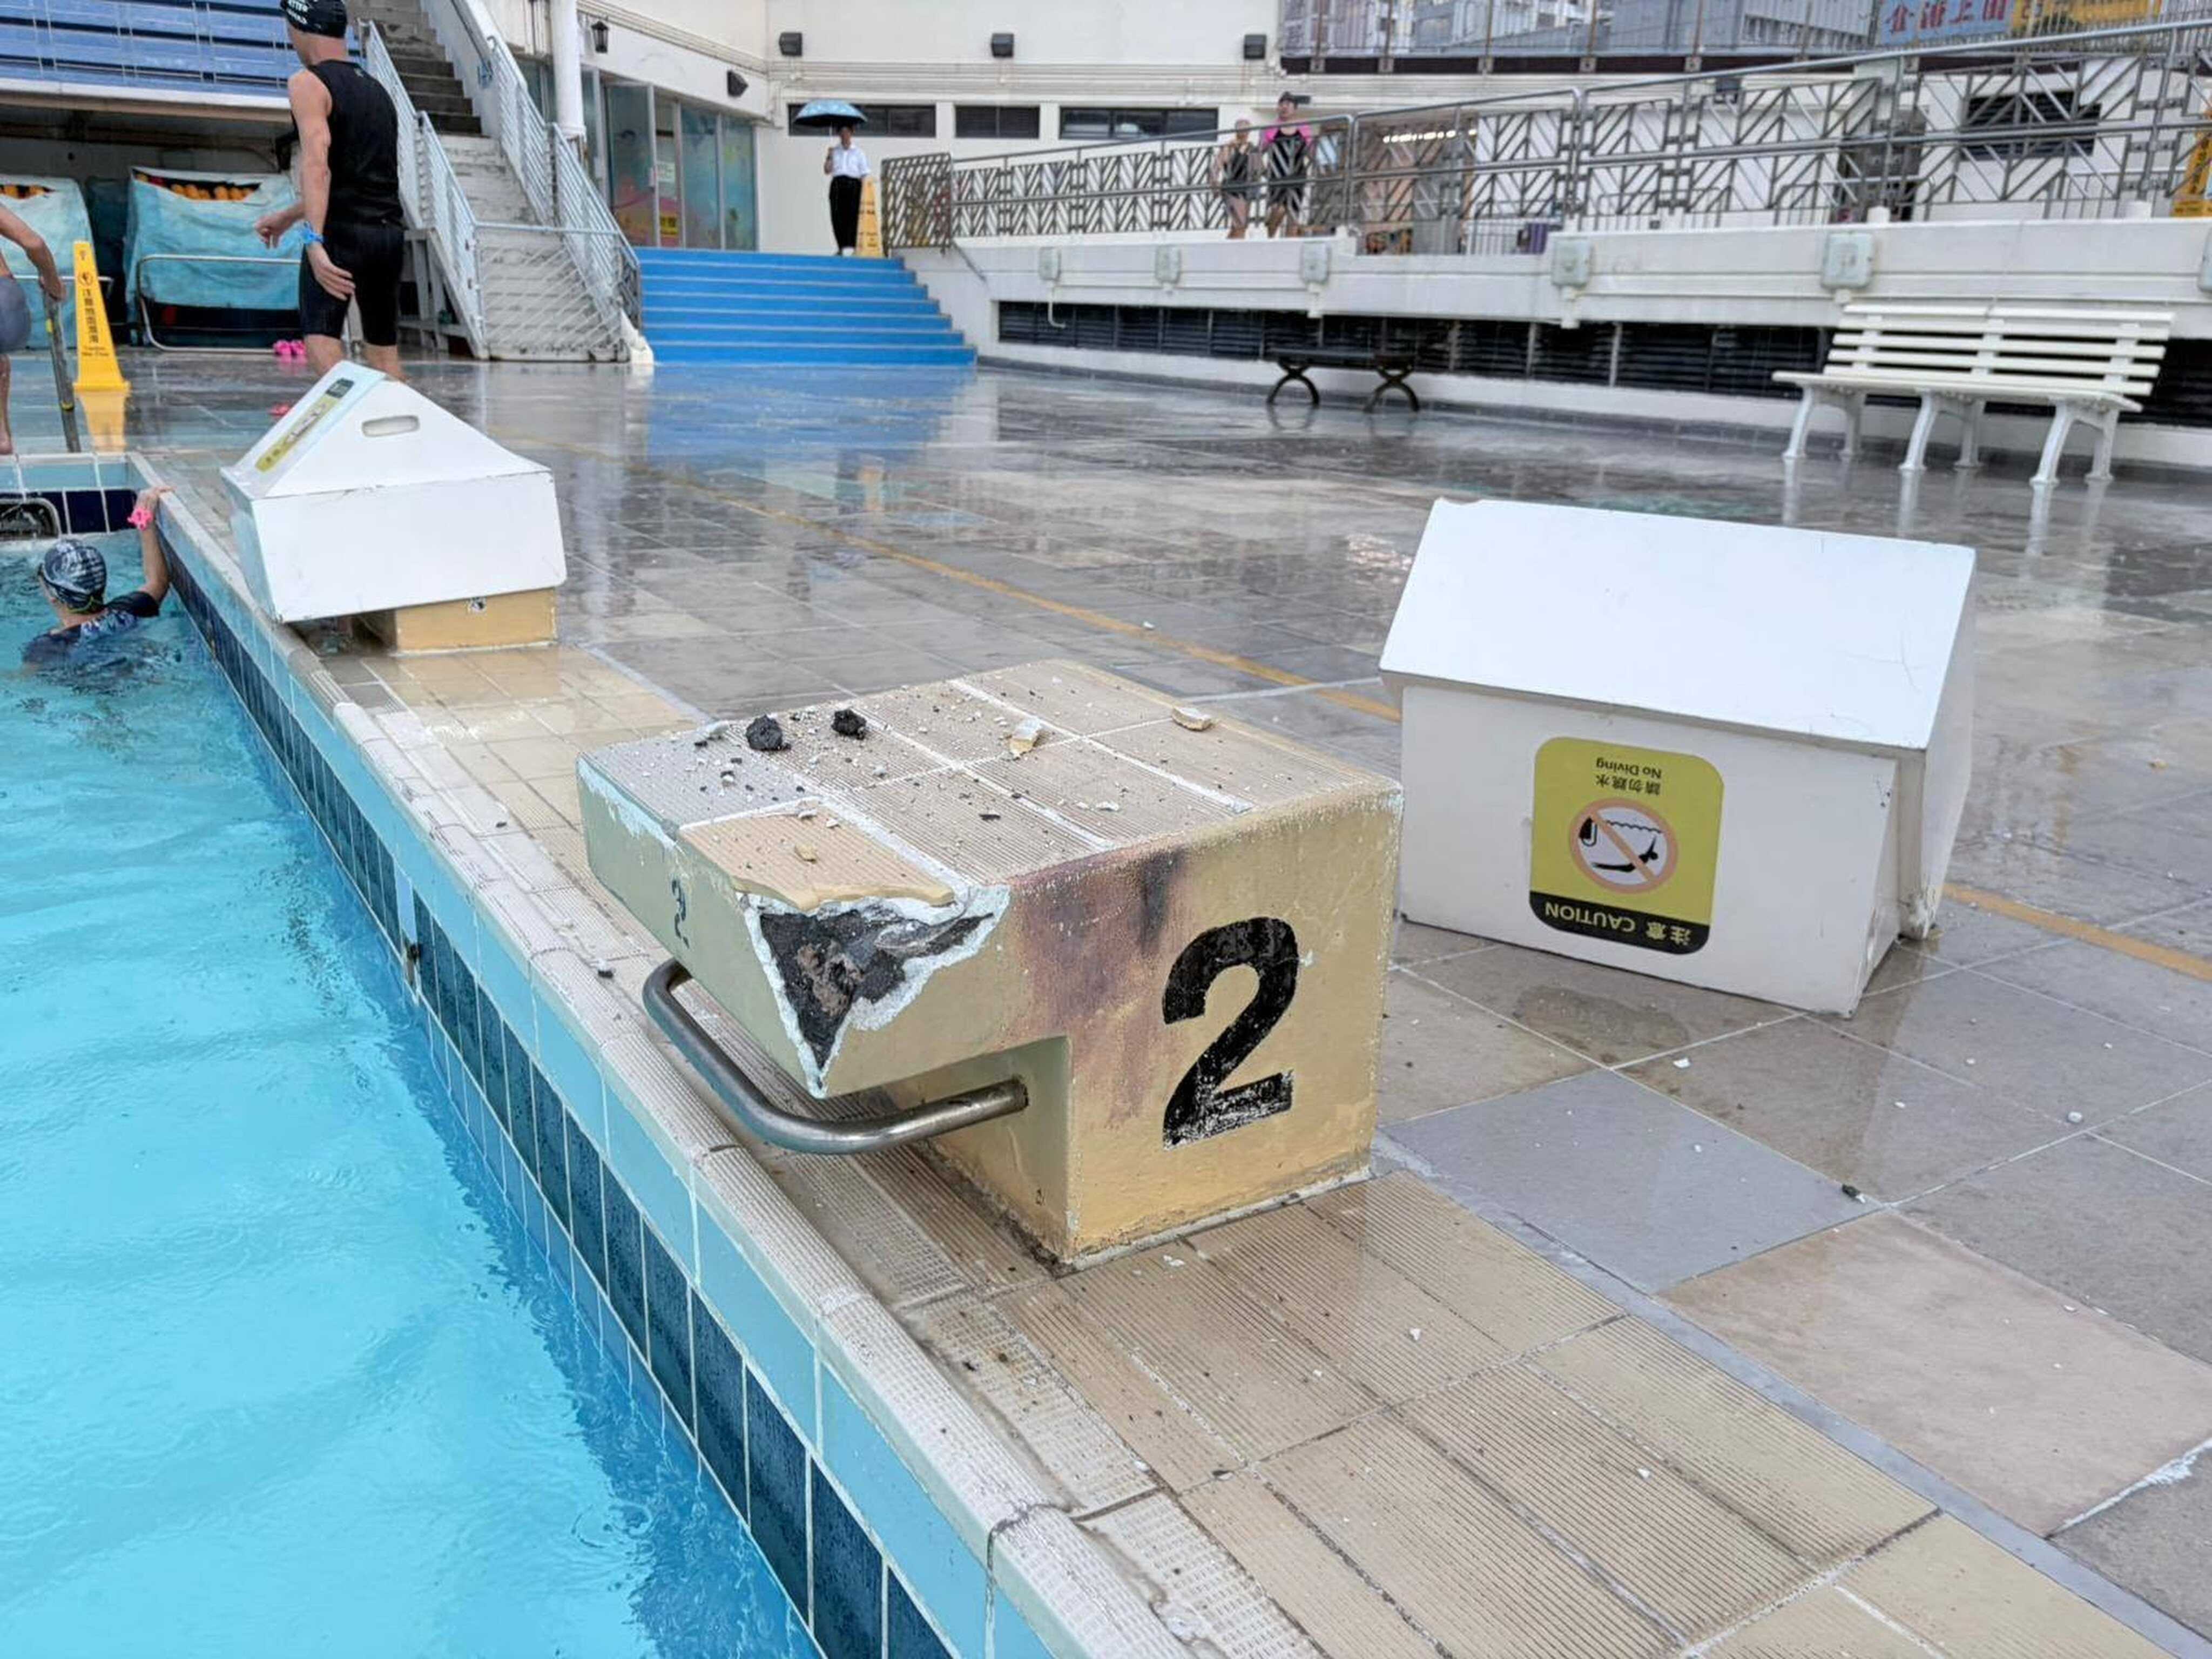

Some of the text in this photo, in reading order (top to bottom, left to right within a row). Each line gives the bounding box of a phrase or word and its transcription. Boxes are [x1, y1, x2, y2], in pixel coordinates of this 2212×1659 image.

[1596, 757, 1662, 779] No Diving
[1596, 774, 1661, 795] 請勿跳水
[1545, 901, 1692, 946] 注意 CAUTION
[1162, 916, 1299, 1151] 2
